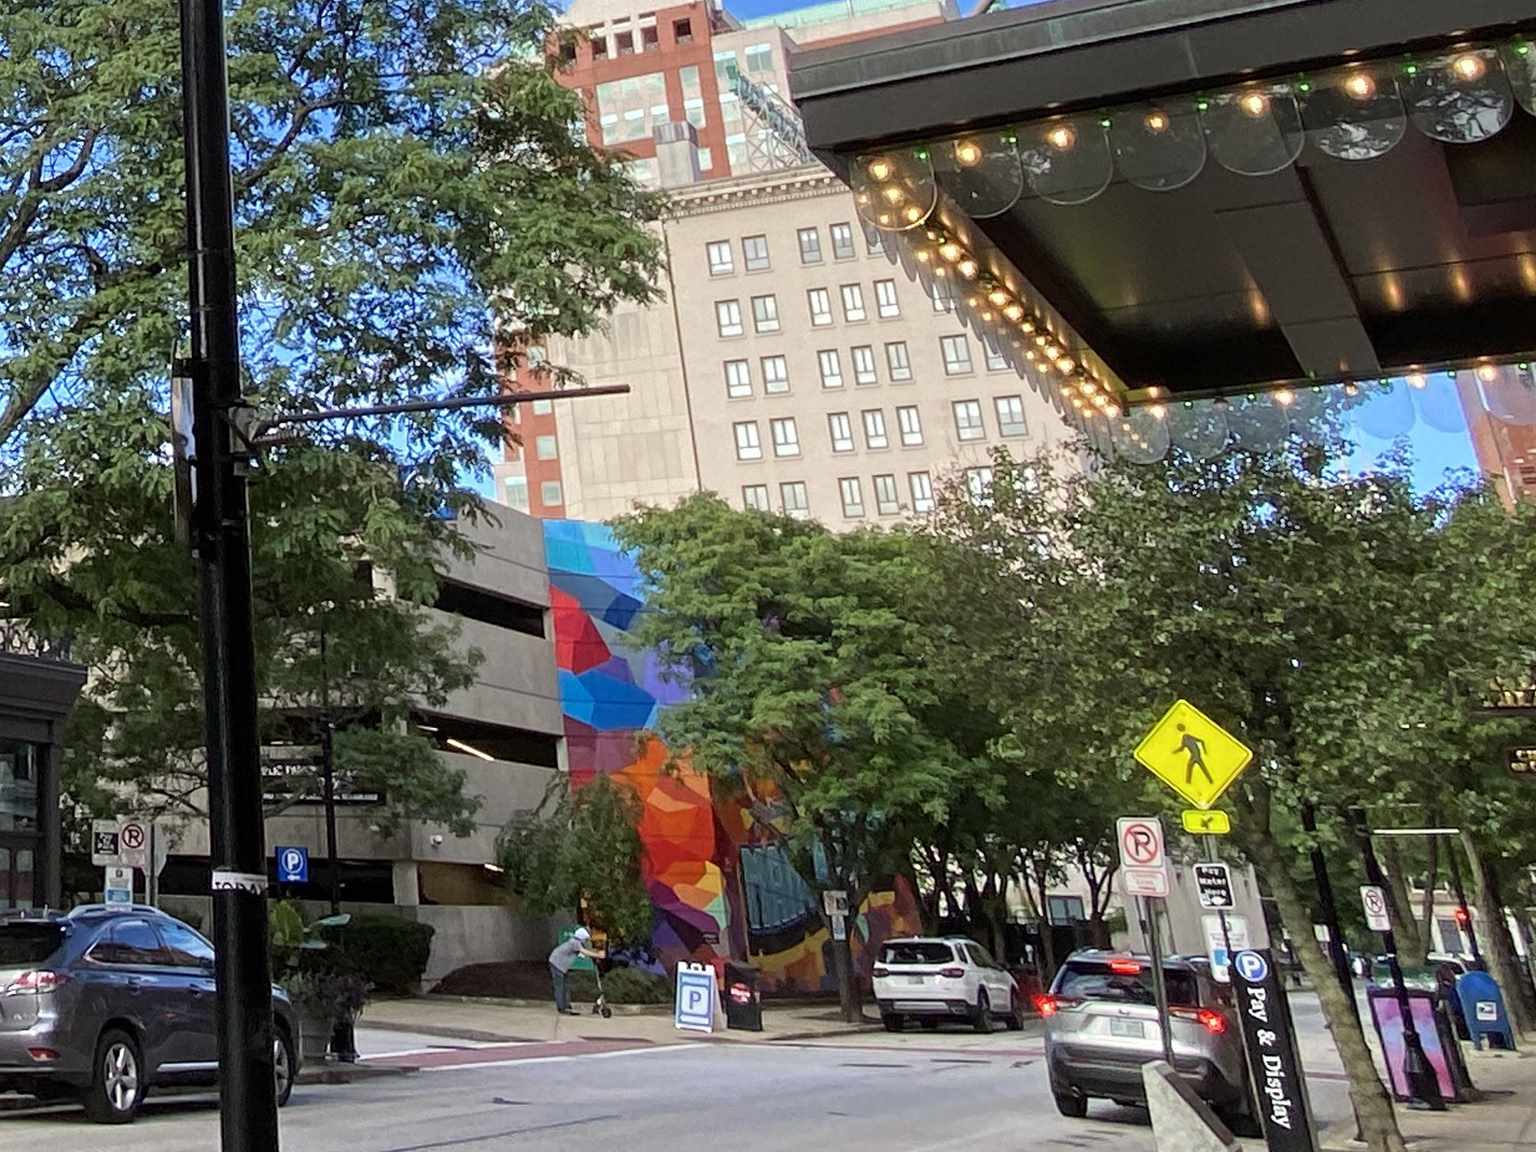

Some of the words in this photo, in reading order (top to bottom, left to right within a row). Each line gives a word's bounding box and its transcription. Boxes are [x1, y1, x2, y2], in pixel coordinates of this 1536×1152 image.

[1247, 987, 1268, 1023] Pay
[1257, 1029, 1276, 1047] &
[1262, 1054, 1292, 1130] Display
